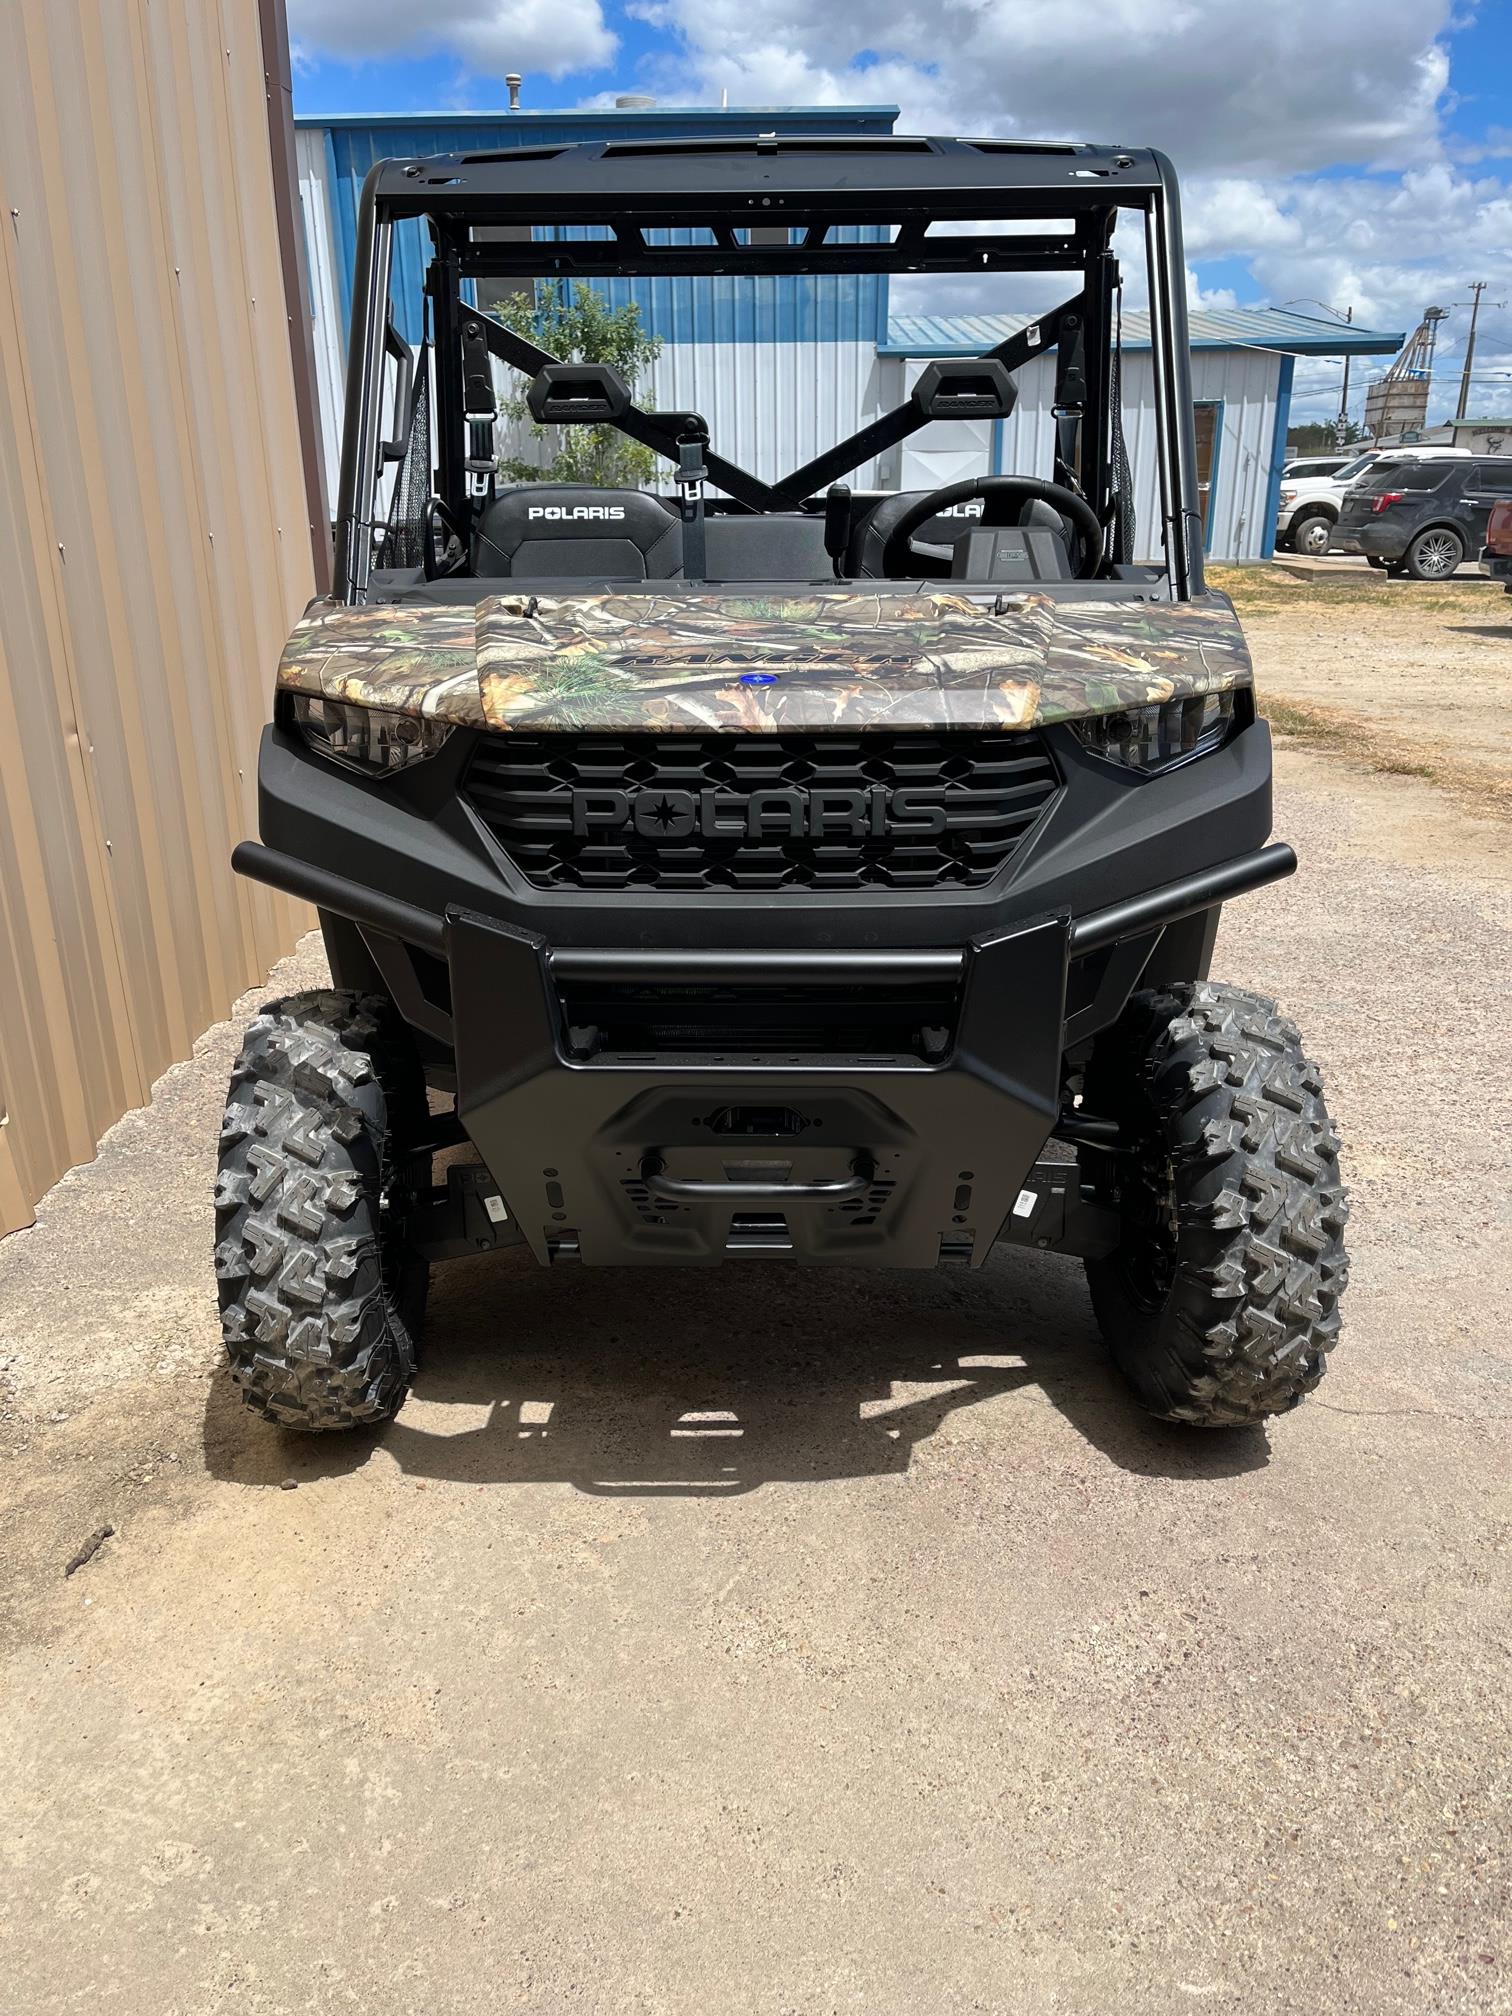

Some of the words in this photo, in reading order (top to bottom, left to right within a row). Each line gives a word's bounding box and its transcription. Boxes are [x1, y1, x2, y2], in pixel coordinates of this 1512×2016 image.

[528, 506, 625, 520] POLARIS
[609, 653, 923, 666] RANGER
[572, 788, 947, 838] POLARIS
